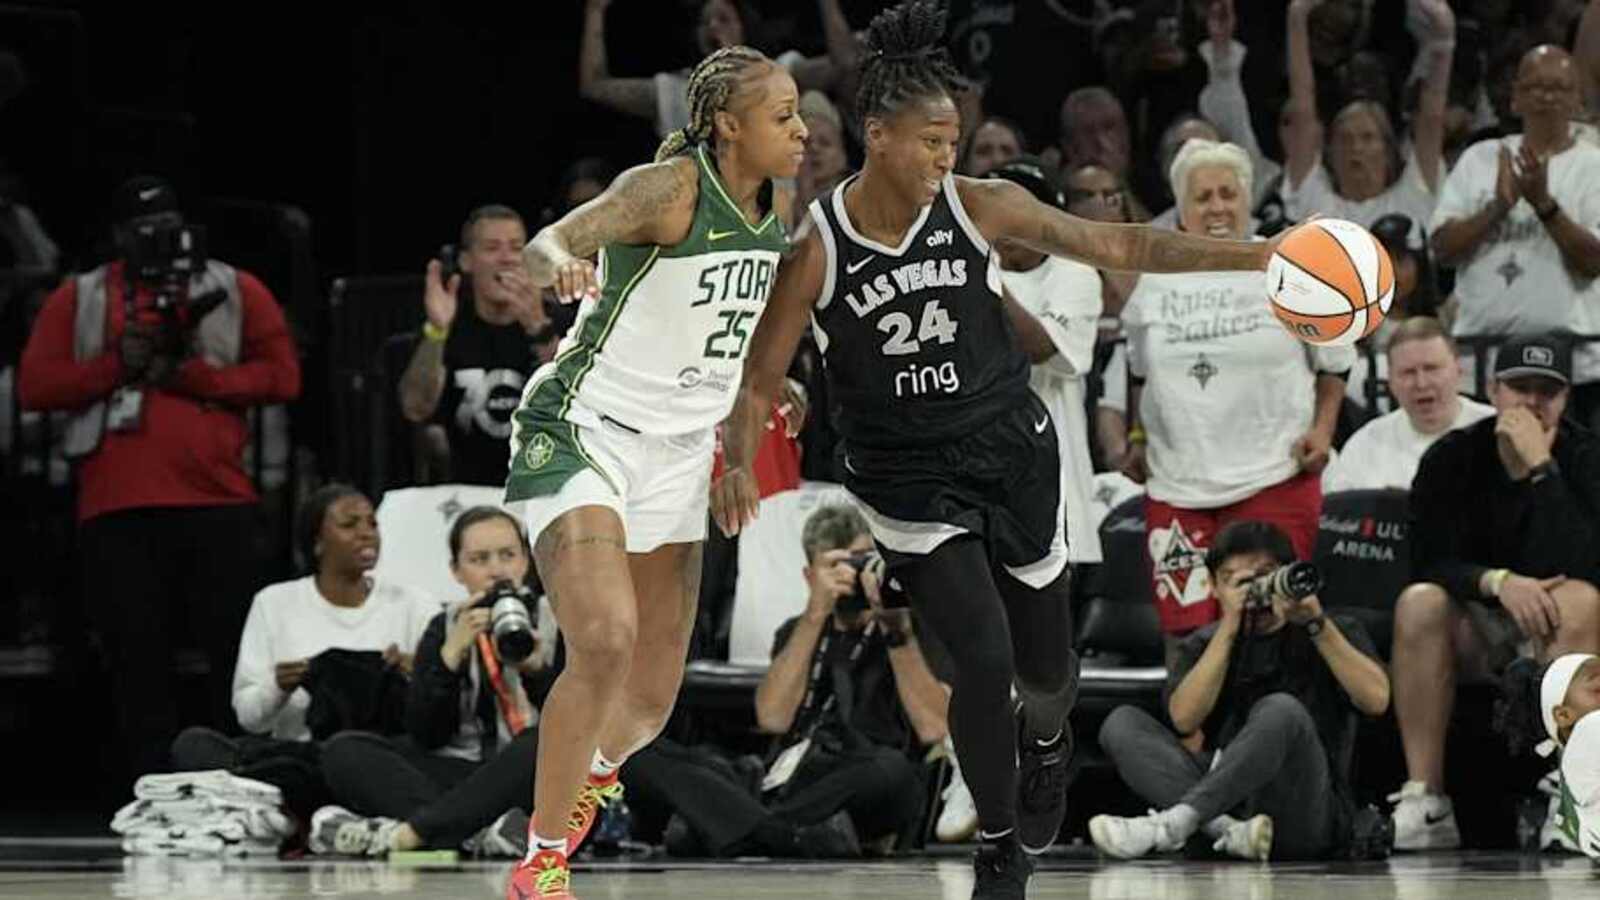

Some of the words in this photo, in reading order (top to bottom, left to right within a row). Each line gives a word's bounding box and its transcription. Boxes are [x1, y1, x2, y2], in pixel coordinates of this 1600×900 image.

[925, 228, 954, 248] ally
[690, 258, 777, 308] STOR
[844, 273, 897, 319] LAS
[891, 258, 968, 295] VEGAS
[703, 309, 757, 359] 25
[876, 299, 958, 356] 24
[894, 361, 960, 397] ring
[1331, 540, 1394, 562] ARENA
